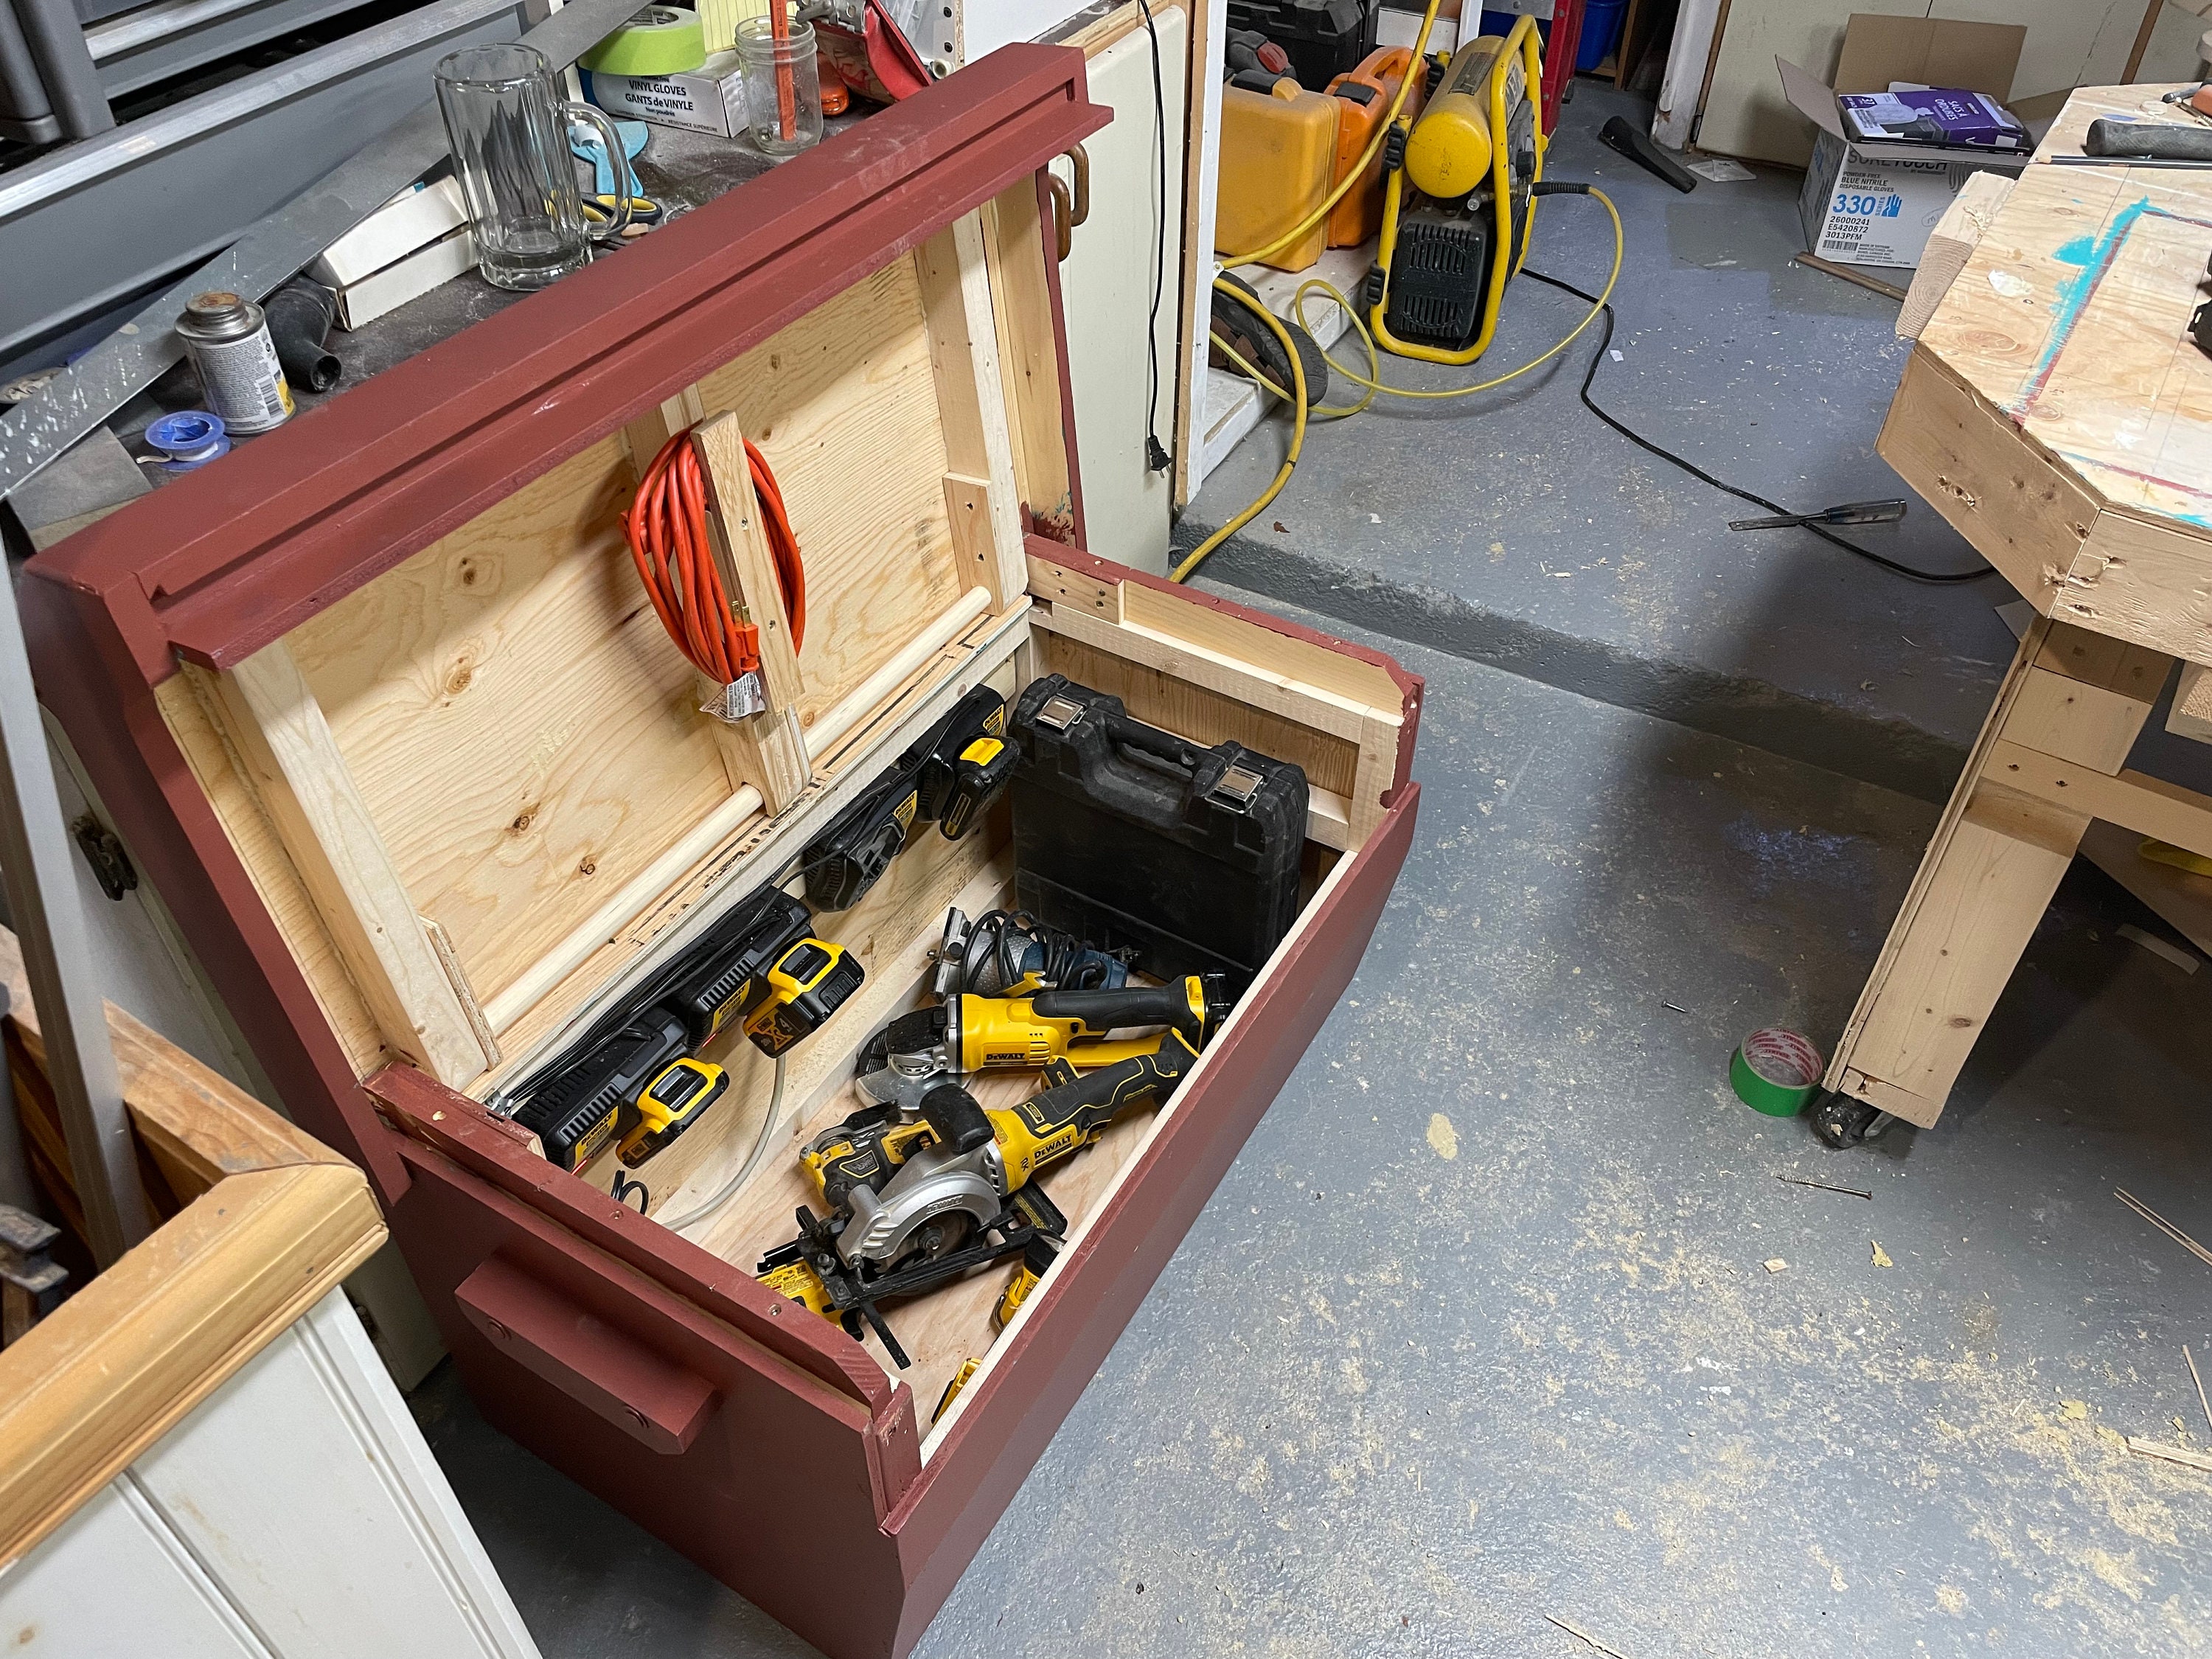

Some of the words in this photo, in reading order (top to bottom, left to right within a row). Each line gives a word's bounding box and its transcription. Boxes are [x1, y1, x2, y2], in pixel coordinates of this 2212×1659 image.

[629, 80, 653, 92] VINYL
[654, 84, 686, 96] GLOVES
[625, 93, 653, 105] GANTS
[654, 97, 664, 107] de
[664, 100, 693, 111] VINYLE
[1839, 183, 1873, 192] DISPOSABLE
[1841, 176, 1860, 184] BLUE
[1861, 178, 1888, 187] NITRILE
[1832, 194, 1877, 216] 330
[1830, 215, 1870, 226] 26000241
[1825, 231, 1863, 241] 3013PFM
[1034, 1134, 1071, 1160] DEWALT
